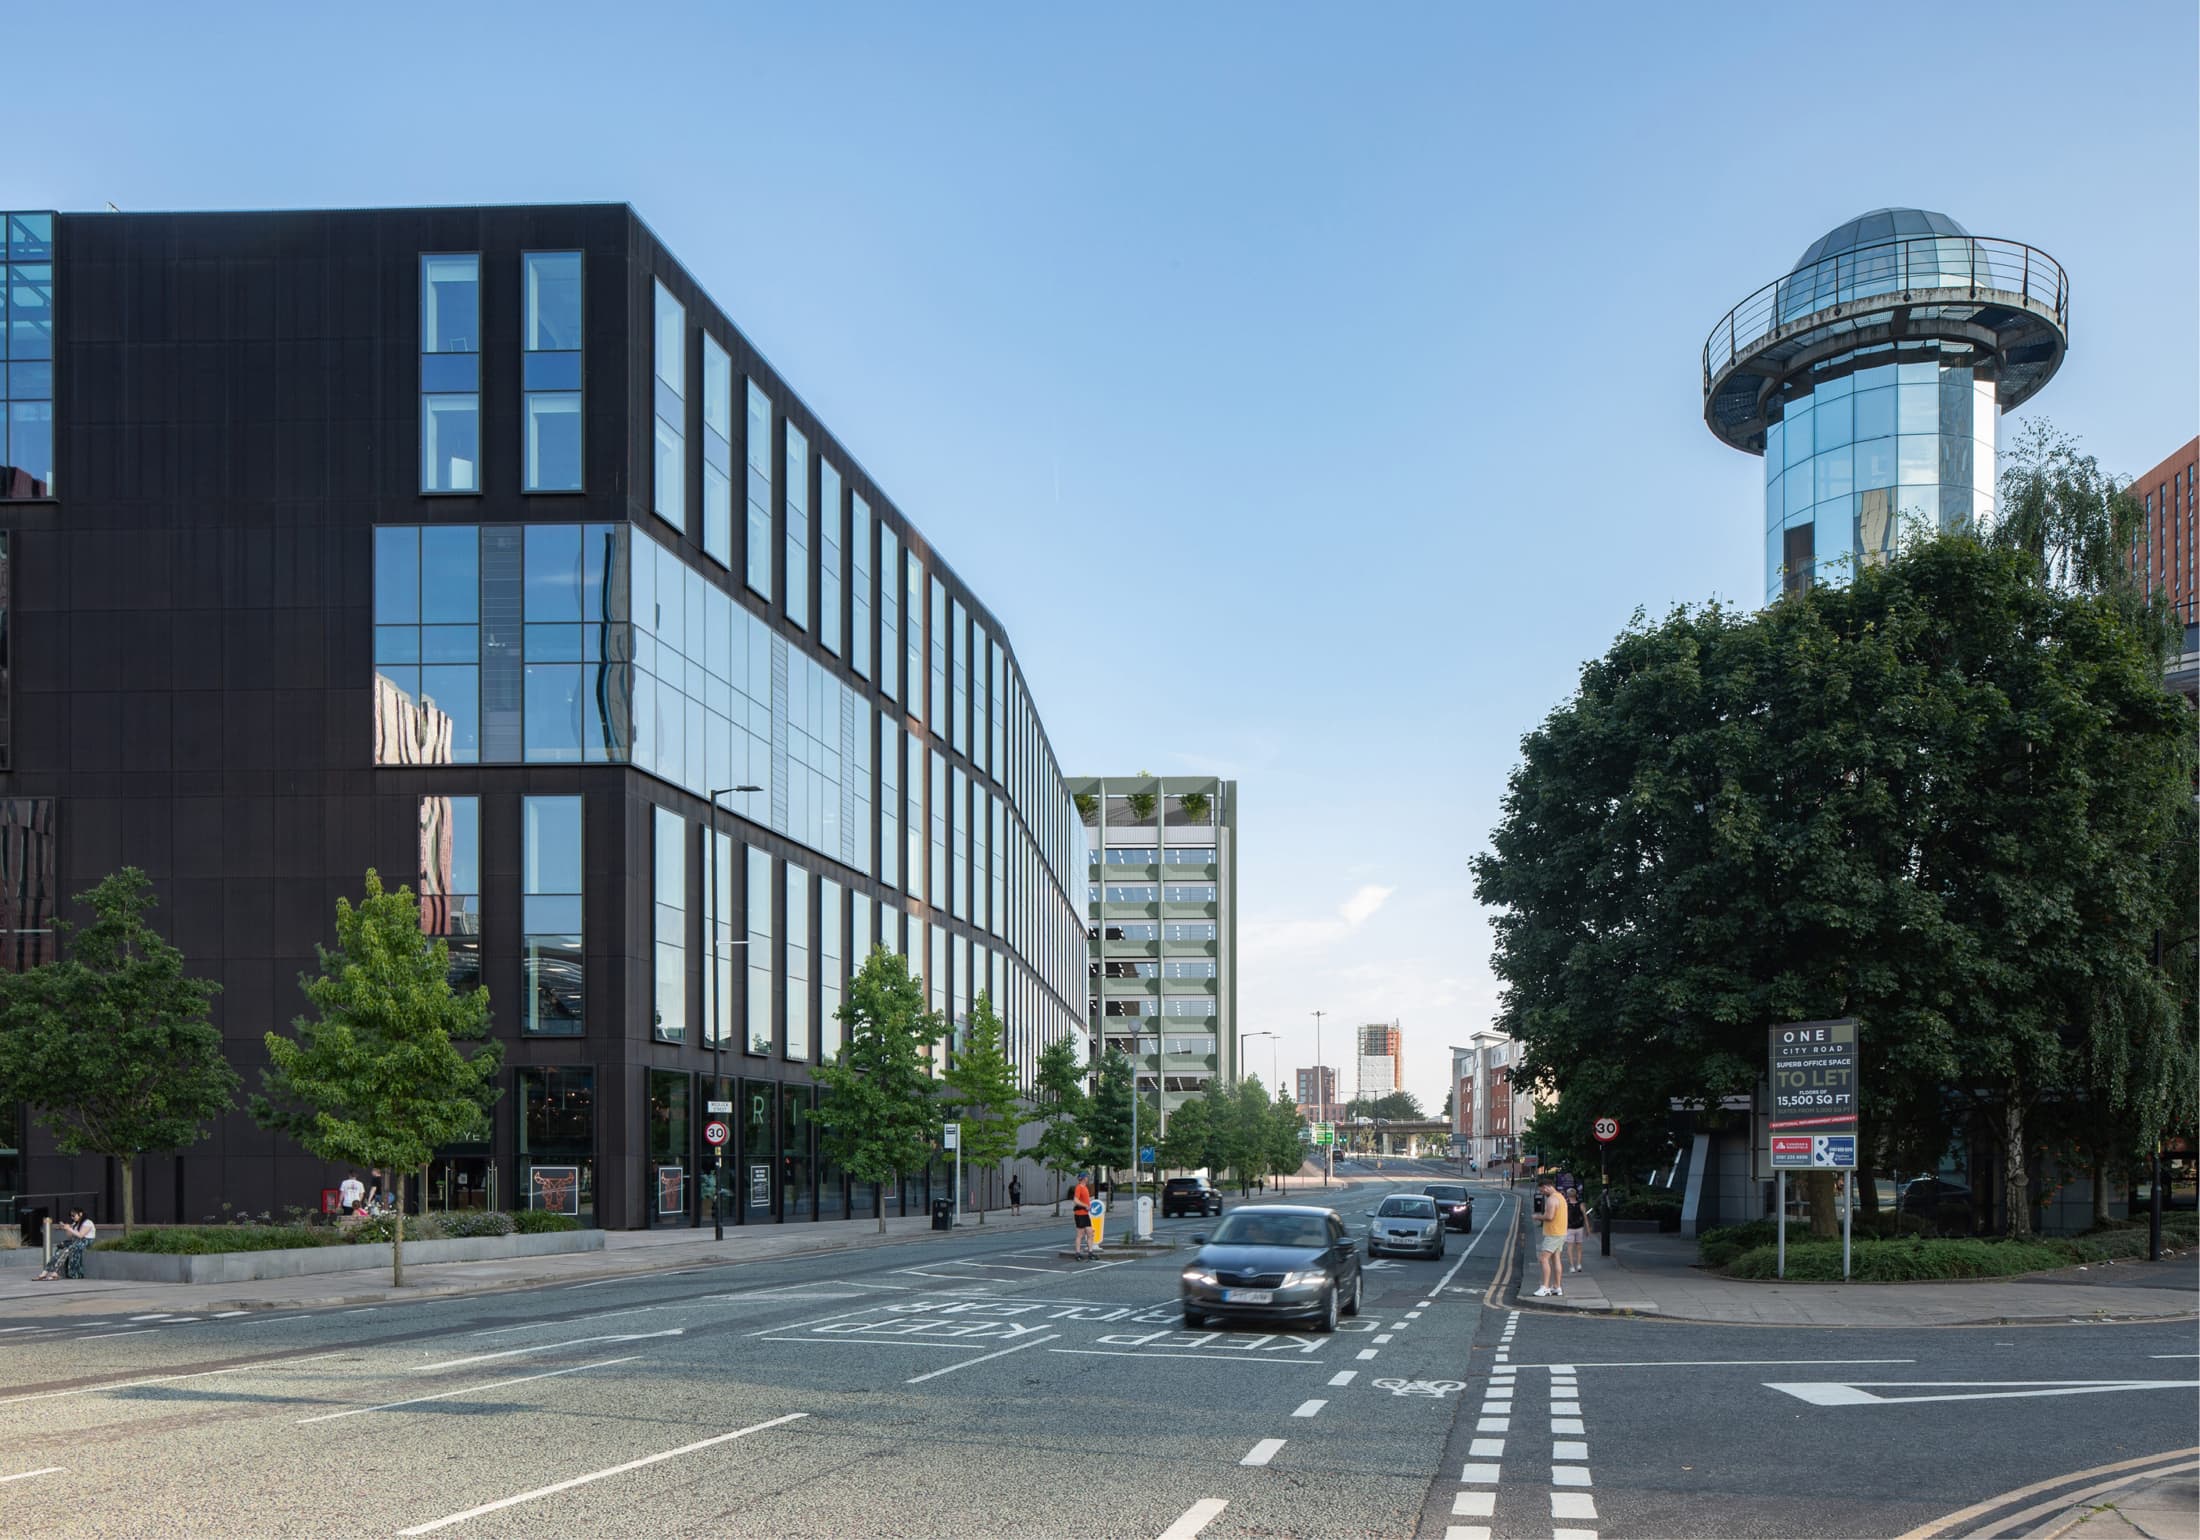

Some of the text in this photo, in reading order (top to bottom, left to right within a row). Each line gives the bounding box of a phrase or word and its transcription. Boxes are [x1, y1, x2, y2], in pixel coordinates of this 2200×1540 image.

[1783, 1029, 1825, 1043] ONE
[1782, 1045, 1843, 1055] CITY ROAD
[1776, 1058, 1852, 1069] SUPERB OFFICE SPACE
[1777, 1069, 1851, 1088] TO LET
[1777, 1094, 1851, 1107] 15,500 SQ FT
[708, 1128, 724, 1138] 30
[1596, 1122, 1616, 1134] 30
[811, 1318, 1054, 1339] KEEP
[1096, 1329, 1331, 1353] KEEP
